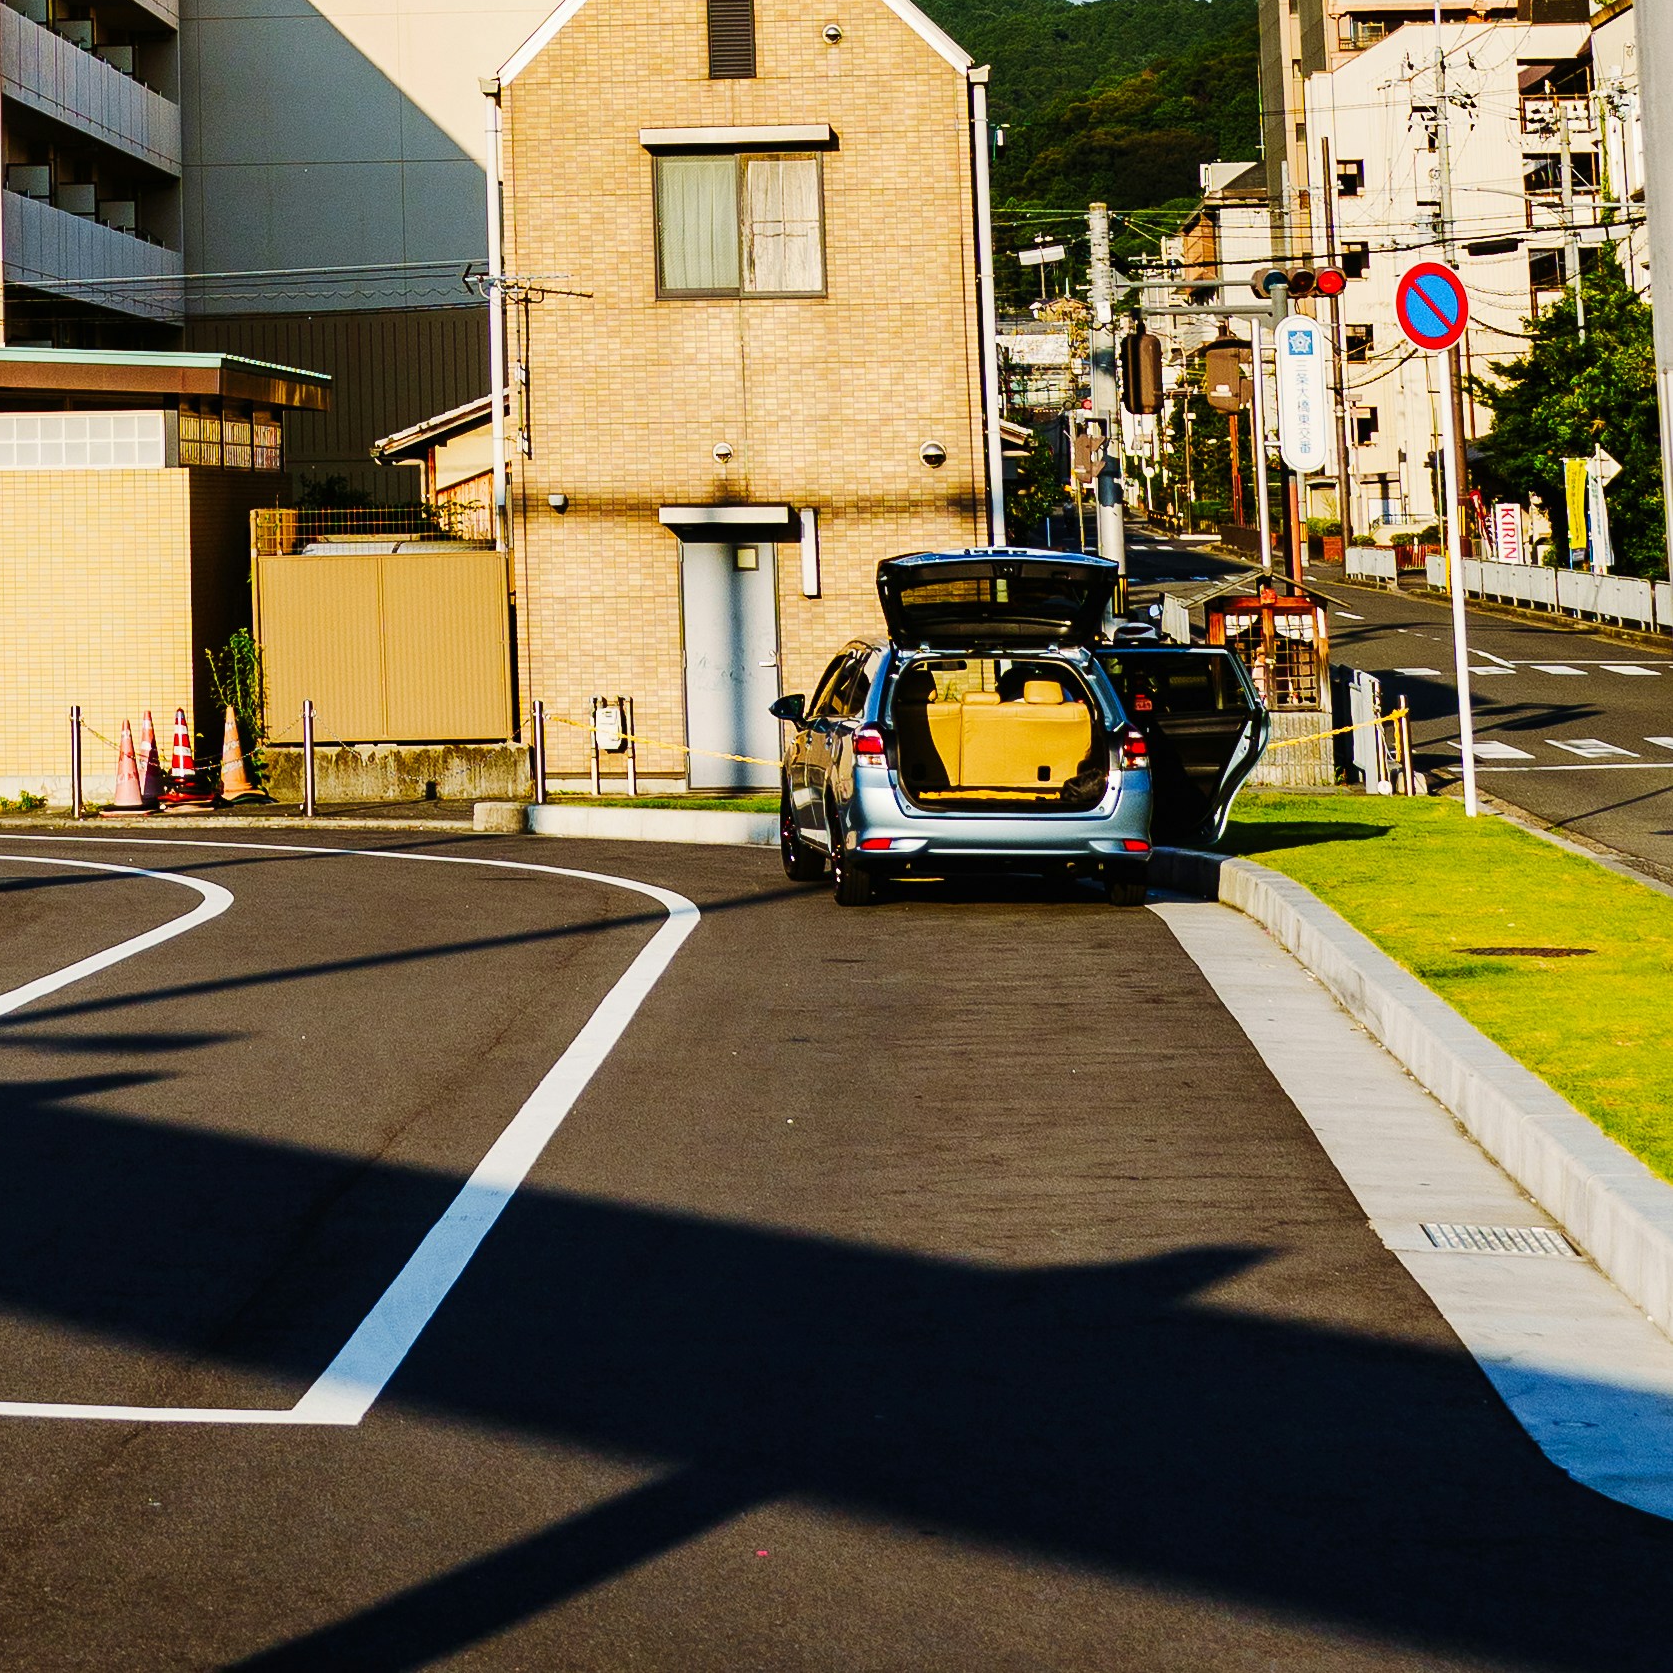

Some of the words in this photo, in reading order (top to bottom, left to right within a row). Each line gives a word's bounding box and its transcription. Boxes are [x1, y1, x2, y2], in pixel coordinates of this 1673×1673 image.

[1295, 359, 1312, 454] 三条大橋東交番
[1500, 508, 1518, 560] KIRIN
